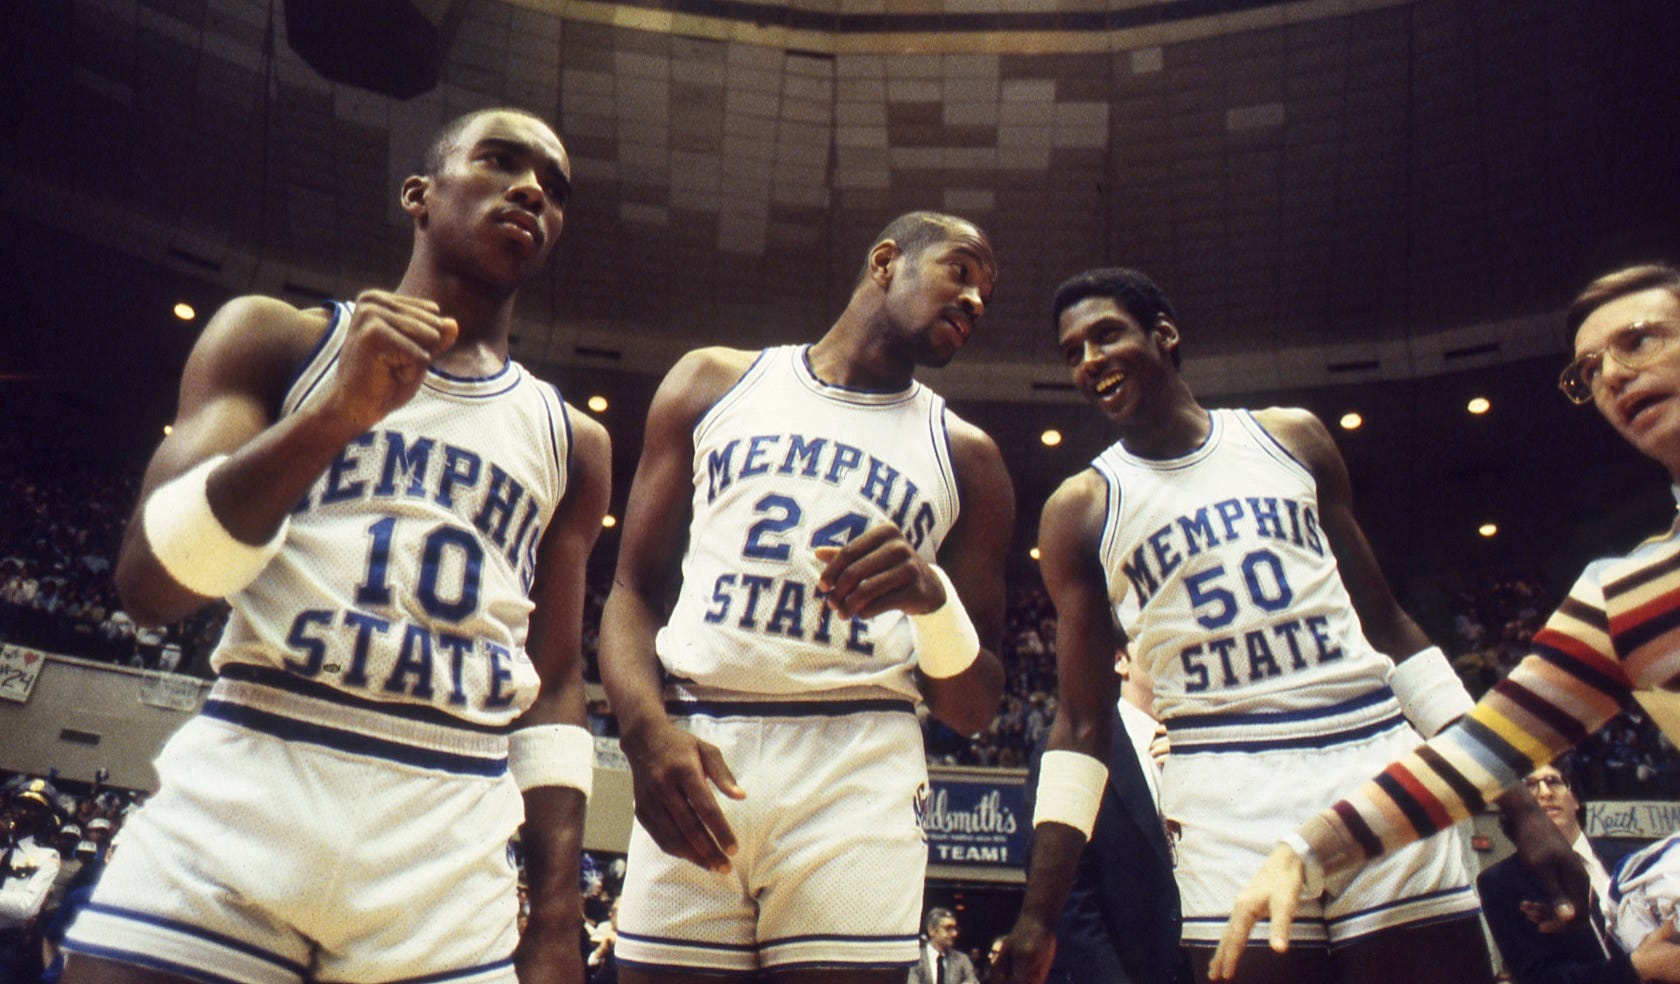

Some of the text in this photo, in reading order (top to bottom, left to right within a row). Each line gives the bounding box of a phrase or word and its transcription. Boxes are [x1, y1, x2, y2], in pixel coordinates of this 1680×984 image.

[291, 430, 539, 597] EMPHIS
[707, 434, 935, 551] MEMPHIS
[354, 516, 485, 625] 10
[1121, 497, 1324, 611] MEMPHIS
[1184, 548, 1293, 630] 50
[283, 609, 516, 707] STATE
[704, 573, 874, 657] STATE
[1180, 615, 1343, 693] STATE
[936, 844, 1008, 862] TEAM!
